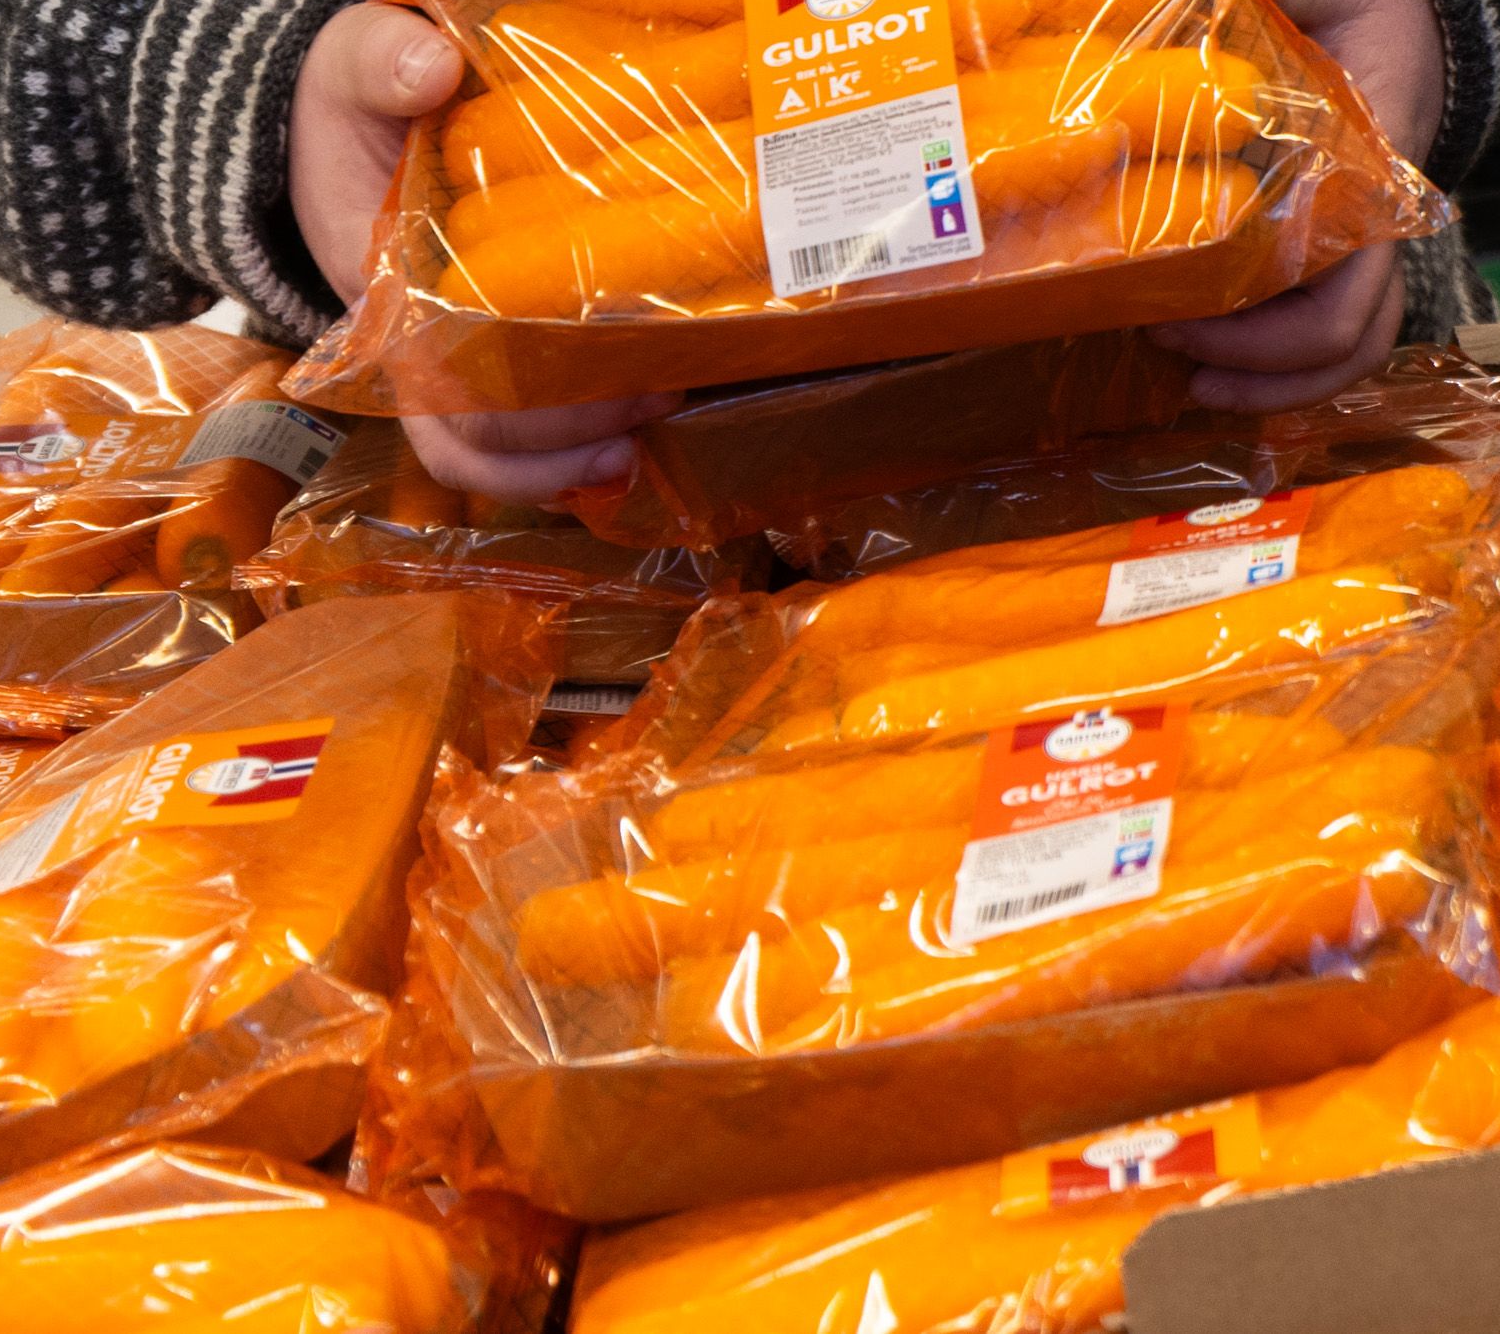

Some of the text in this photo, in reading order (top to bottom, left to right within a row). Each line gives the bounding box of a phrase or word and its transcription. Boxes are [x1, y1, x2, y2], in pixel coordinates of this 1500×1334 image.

[762, 5, 932, 68] GULROT
[779, 87, 806, 112] A
[122, 741, 194, 826] GULROT
[1000, 760, 1160, 808] GULROT
